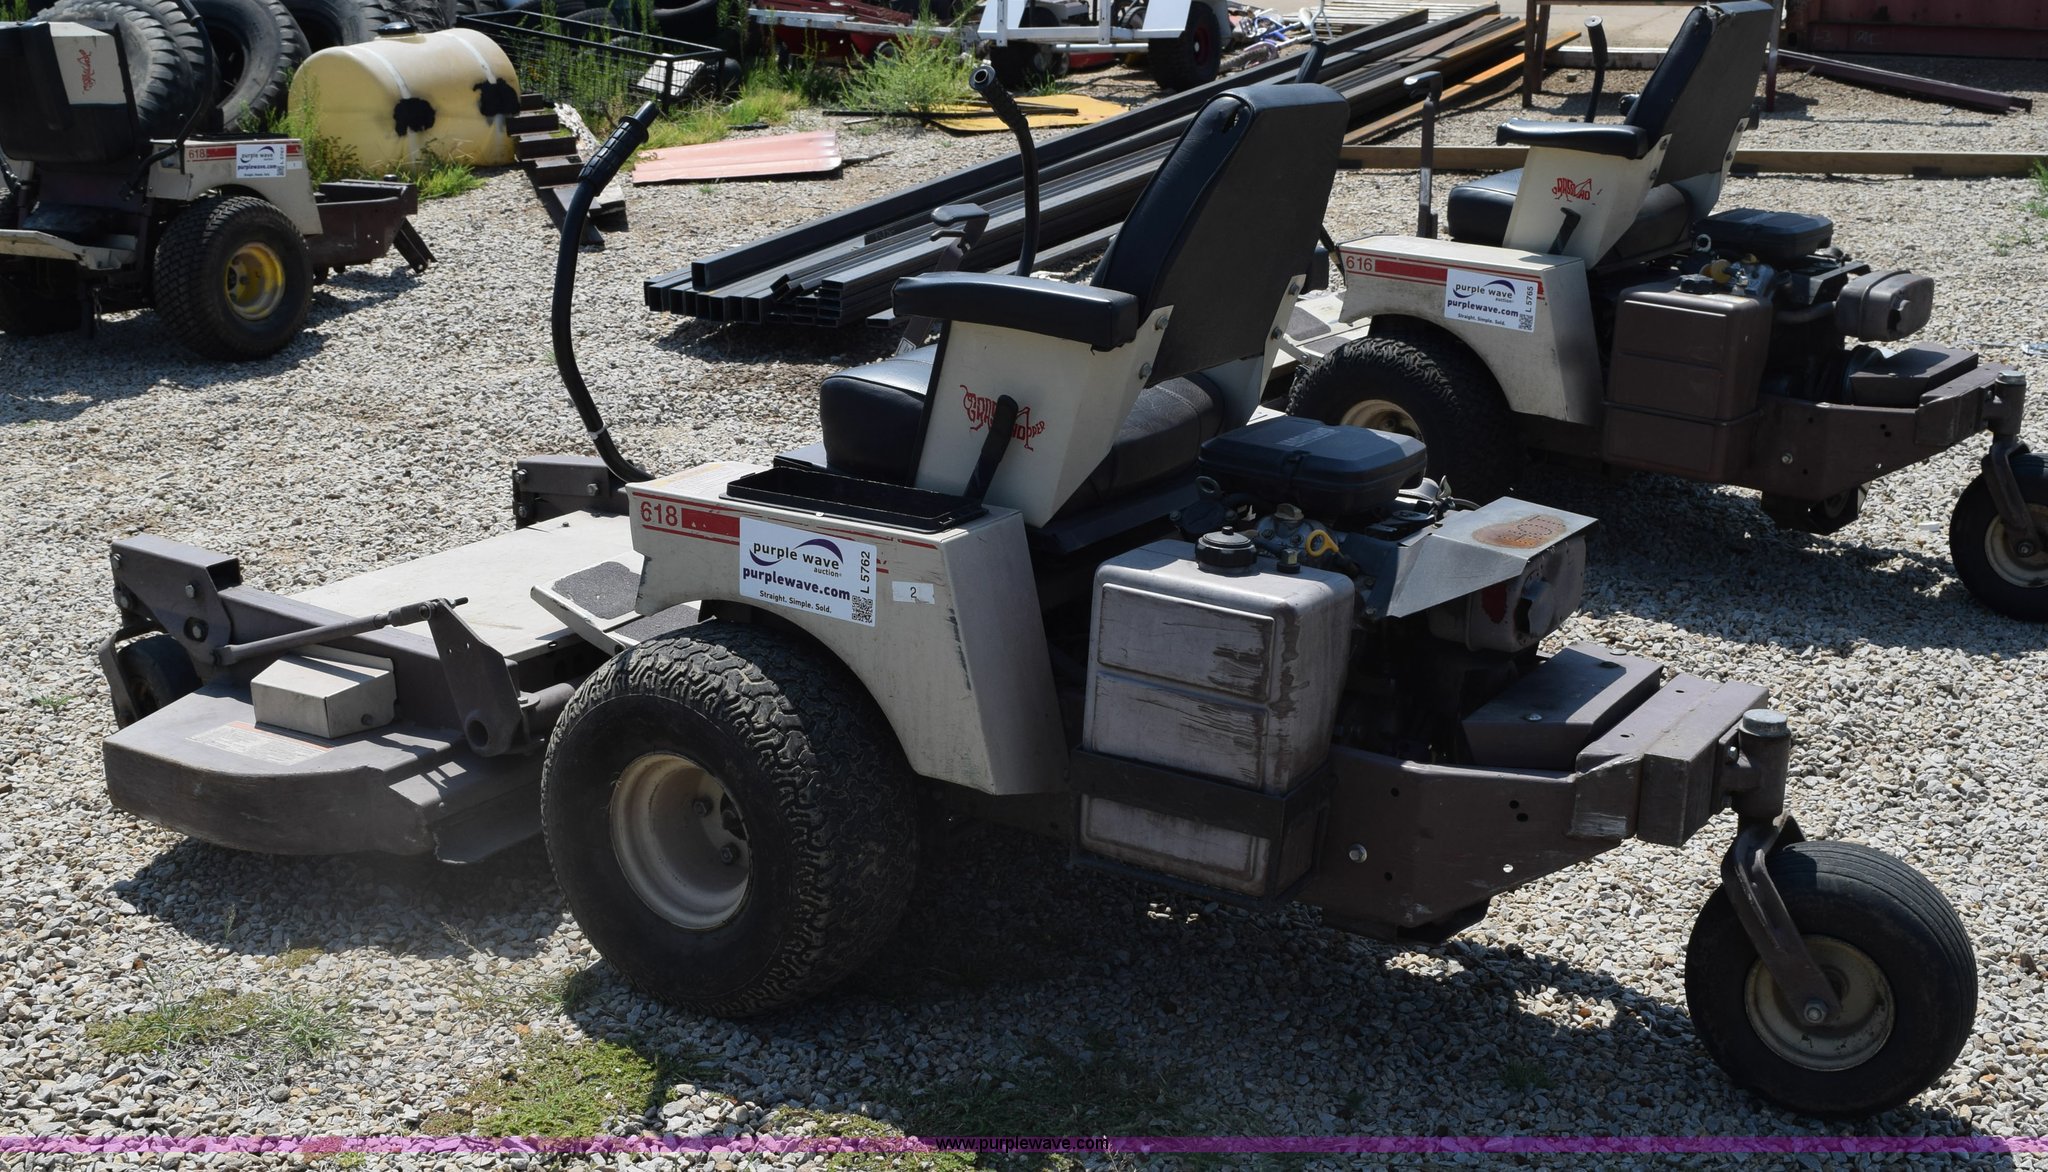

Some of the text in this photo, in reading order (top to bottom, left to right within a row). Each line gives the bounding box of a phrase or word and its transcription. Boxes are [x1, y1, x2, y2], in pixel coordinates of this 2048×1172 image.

[188, 149, 206, 159] 618
[1346, 255, 1372, 271] 616
[1455, 283, 1512, 298] purple wave
[1525, 286, 1533, 305] 5765
[1447, 299, 1519, 317] purplewave.com
[640, 501, 678, 527] 618
[753, 542, 840, 570] purple wave
[814, 567, 838, 577] auction
[860, 551, 870, 594] L 5762
[743, 567, 850, 601] purplewave.com
[909, 586, 917, 599] 2
[759, 590, 832, 614] Straight. Simple. Sold.
